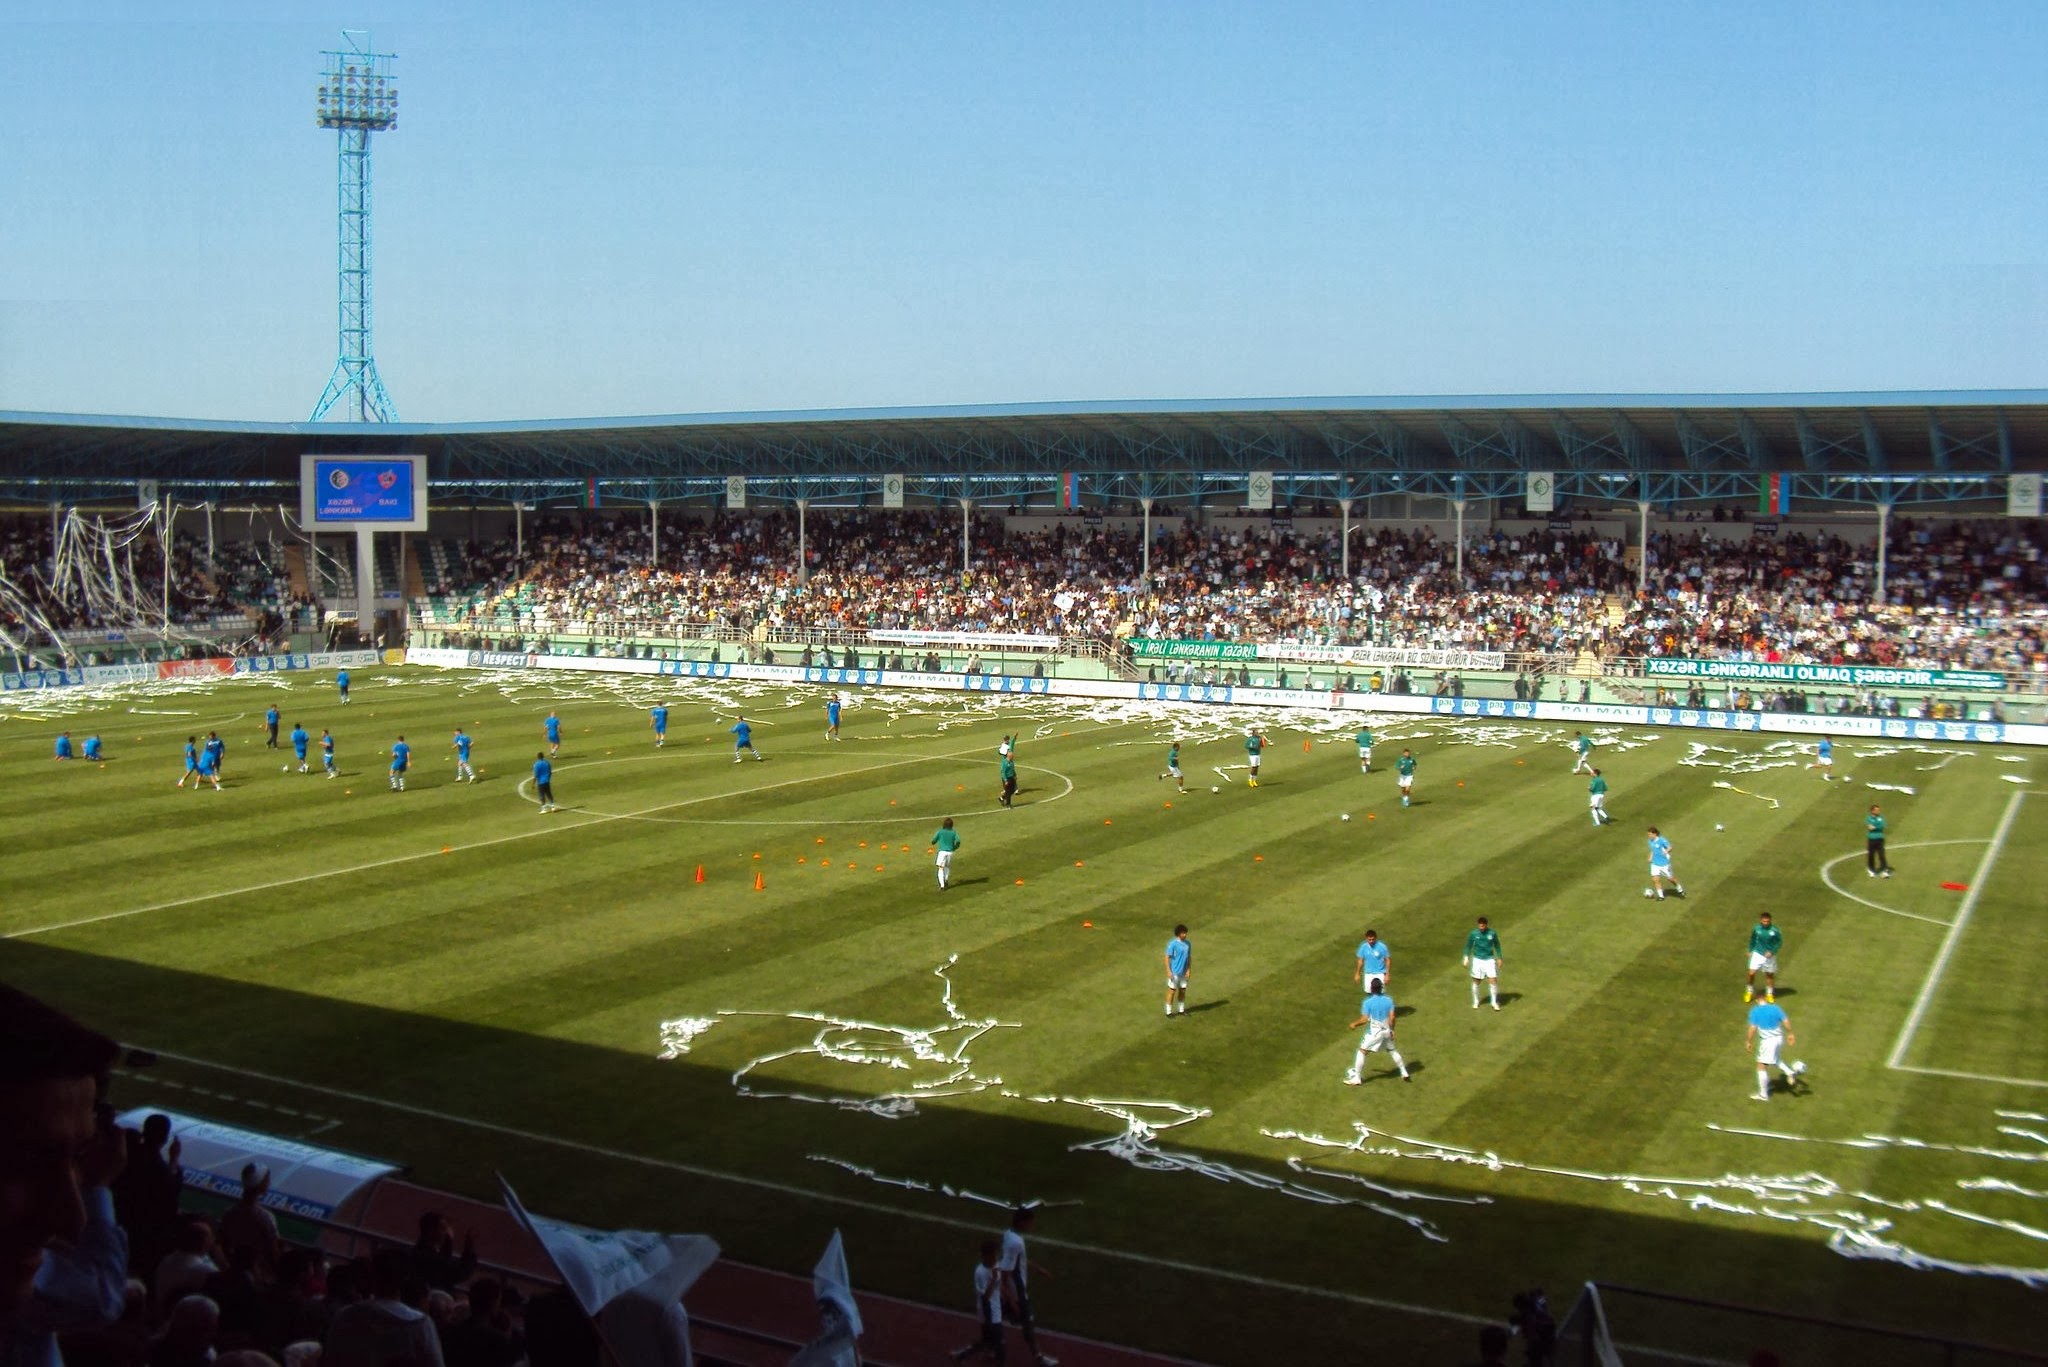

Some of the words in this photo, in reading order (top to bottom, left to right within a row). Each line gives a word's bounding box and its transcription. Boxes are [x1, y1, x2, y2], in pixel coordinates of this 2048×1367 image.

[482, 652, 530, 666] RESPECT
[1649, 661, 1698, 674] XƏZƏR
[1700, 664, 1794, 679] LƏNKƏRANLI
[1797, 669, 1851, 682] OLMAQ
